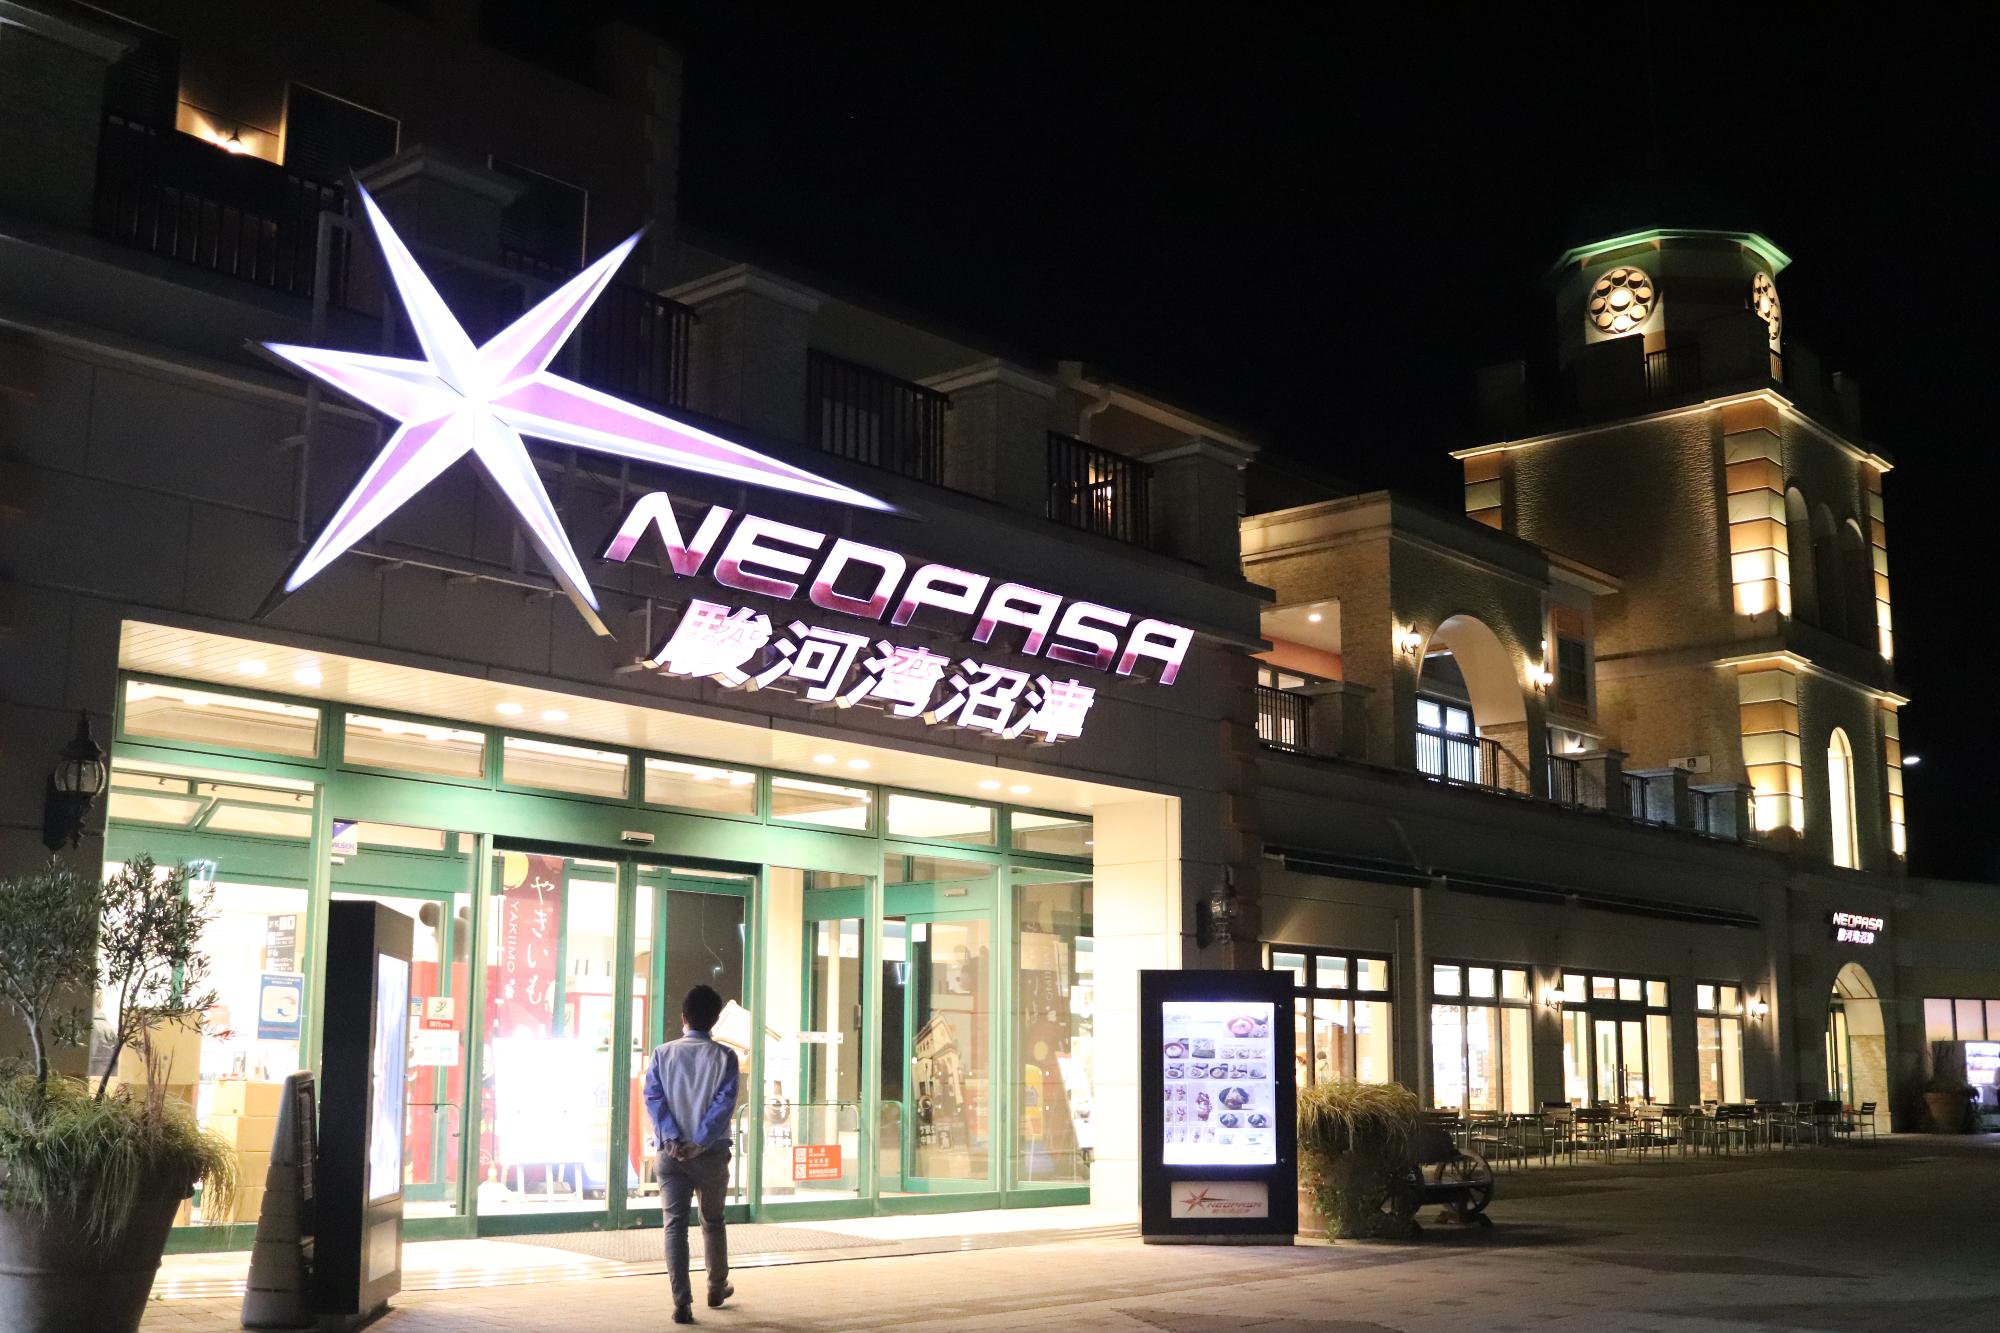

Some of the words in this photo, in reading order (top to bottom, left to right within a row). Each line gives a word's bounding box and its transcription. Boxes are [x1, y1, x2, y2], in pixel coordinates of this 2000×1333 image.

[603, 491, 1196, 686] NEOPASA
[655, 599, 1097, 744] 駿河湾沼津
[507, 901, 519, 973] YAKIIMO
[529, 876, 555, 1005] やきいも
[1833, 912, 1884, 931] NEOPASA
